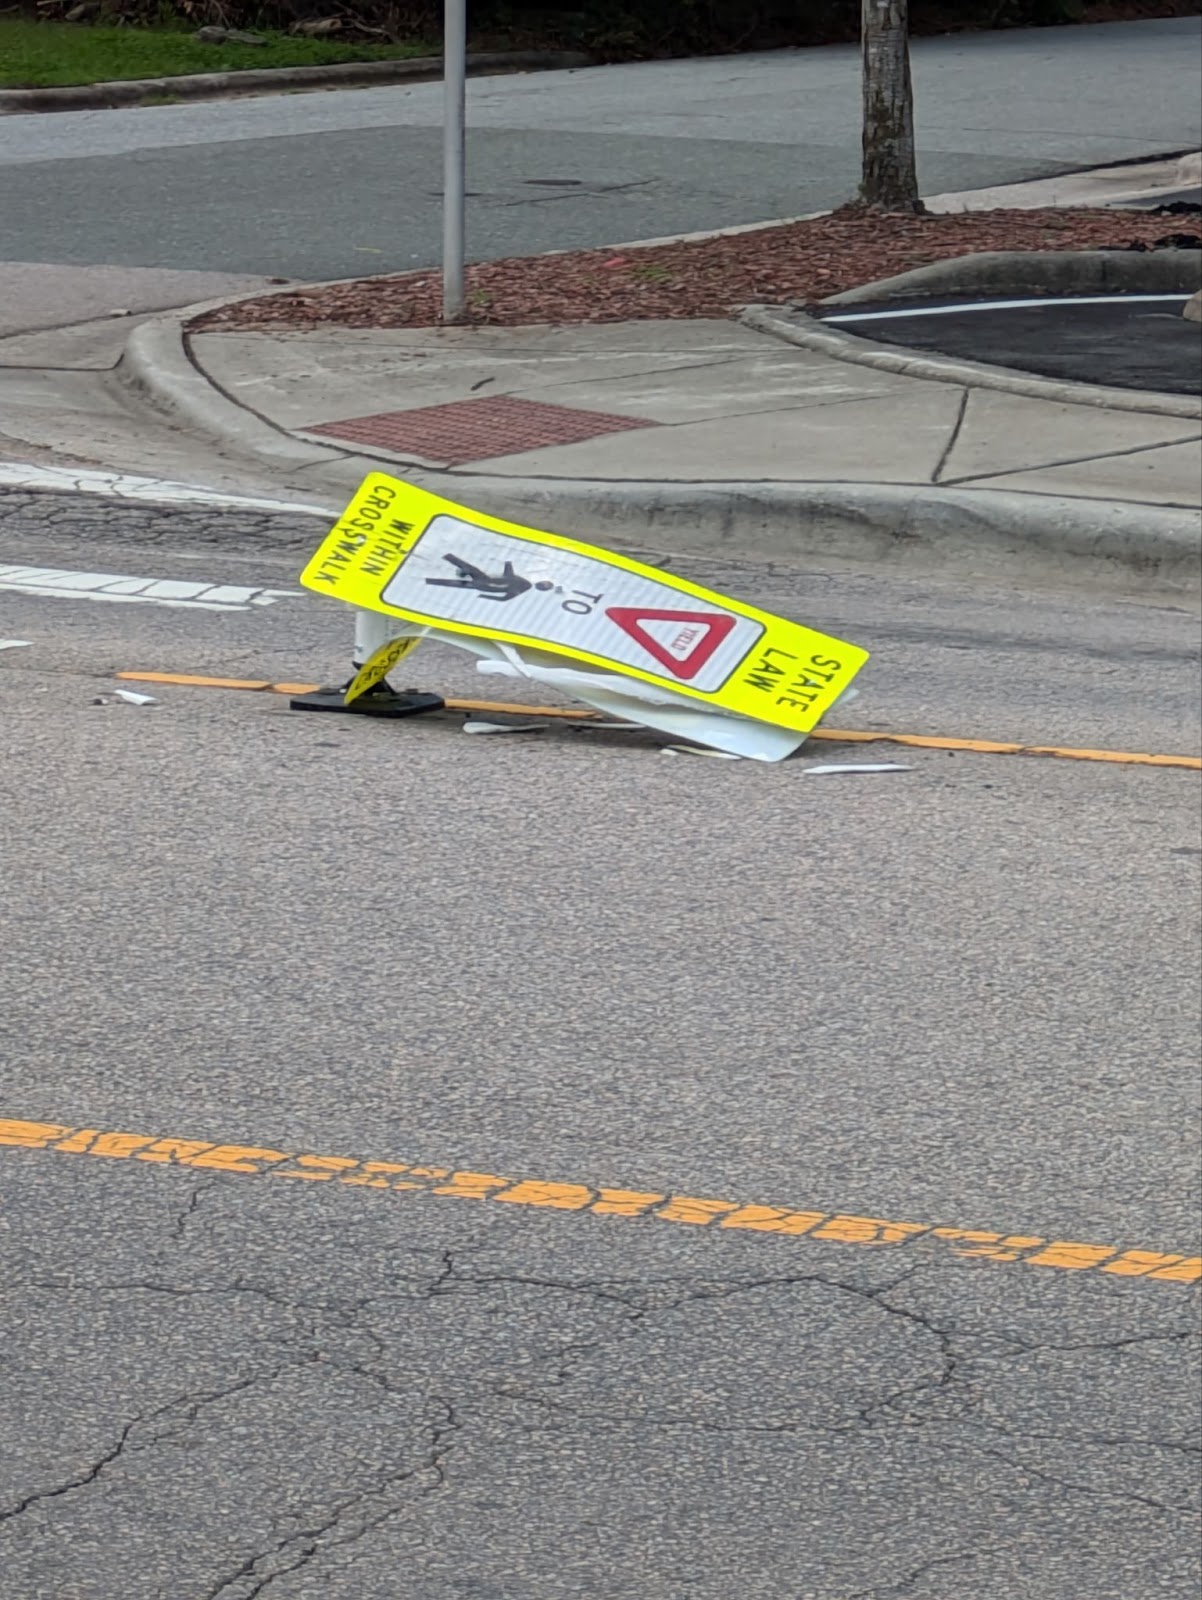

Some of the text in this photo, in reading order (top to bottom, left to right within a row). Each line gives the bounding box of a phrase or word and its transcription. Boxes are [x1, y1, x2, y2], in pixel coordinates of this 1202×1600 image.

[314, 485, 397, 585] CROSSWALK
[360, 518, 416, 577] WITHIN
[562, 590, 604, 615] TO
[671, 627, 699, 651] YIELD
[743, 647, 798, 692] LAW
[776, 655, 841, 713] STATE
